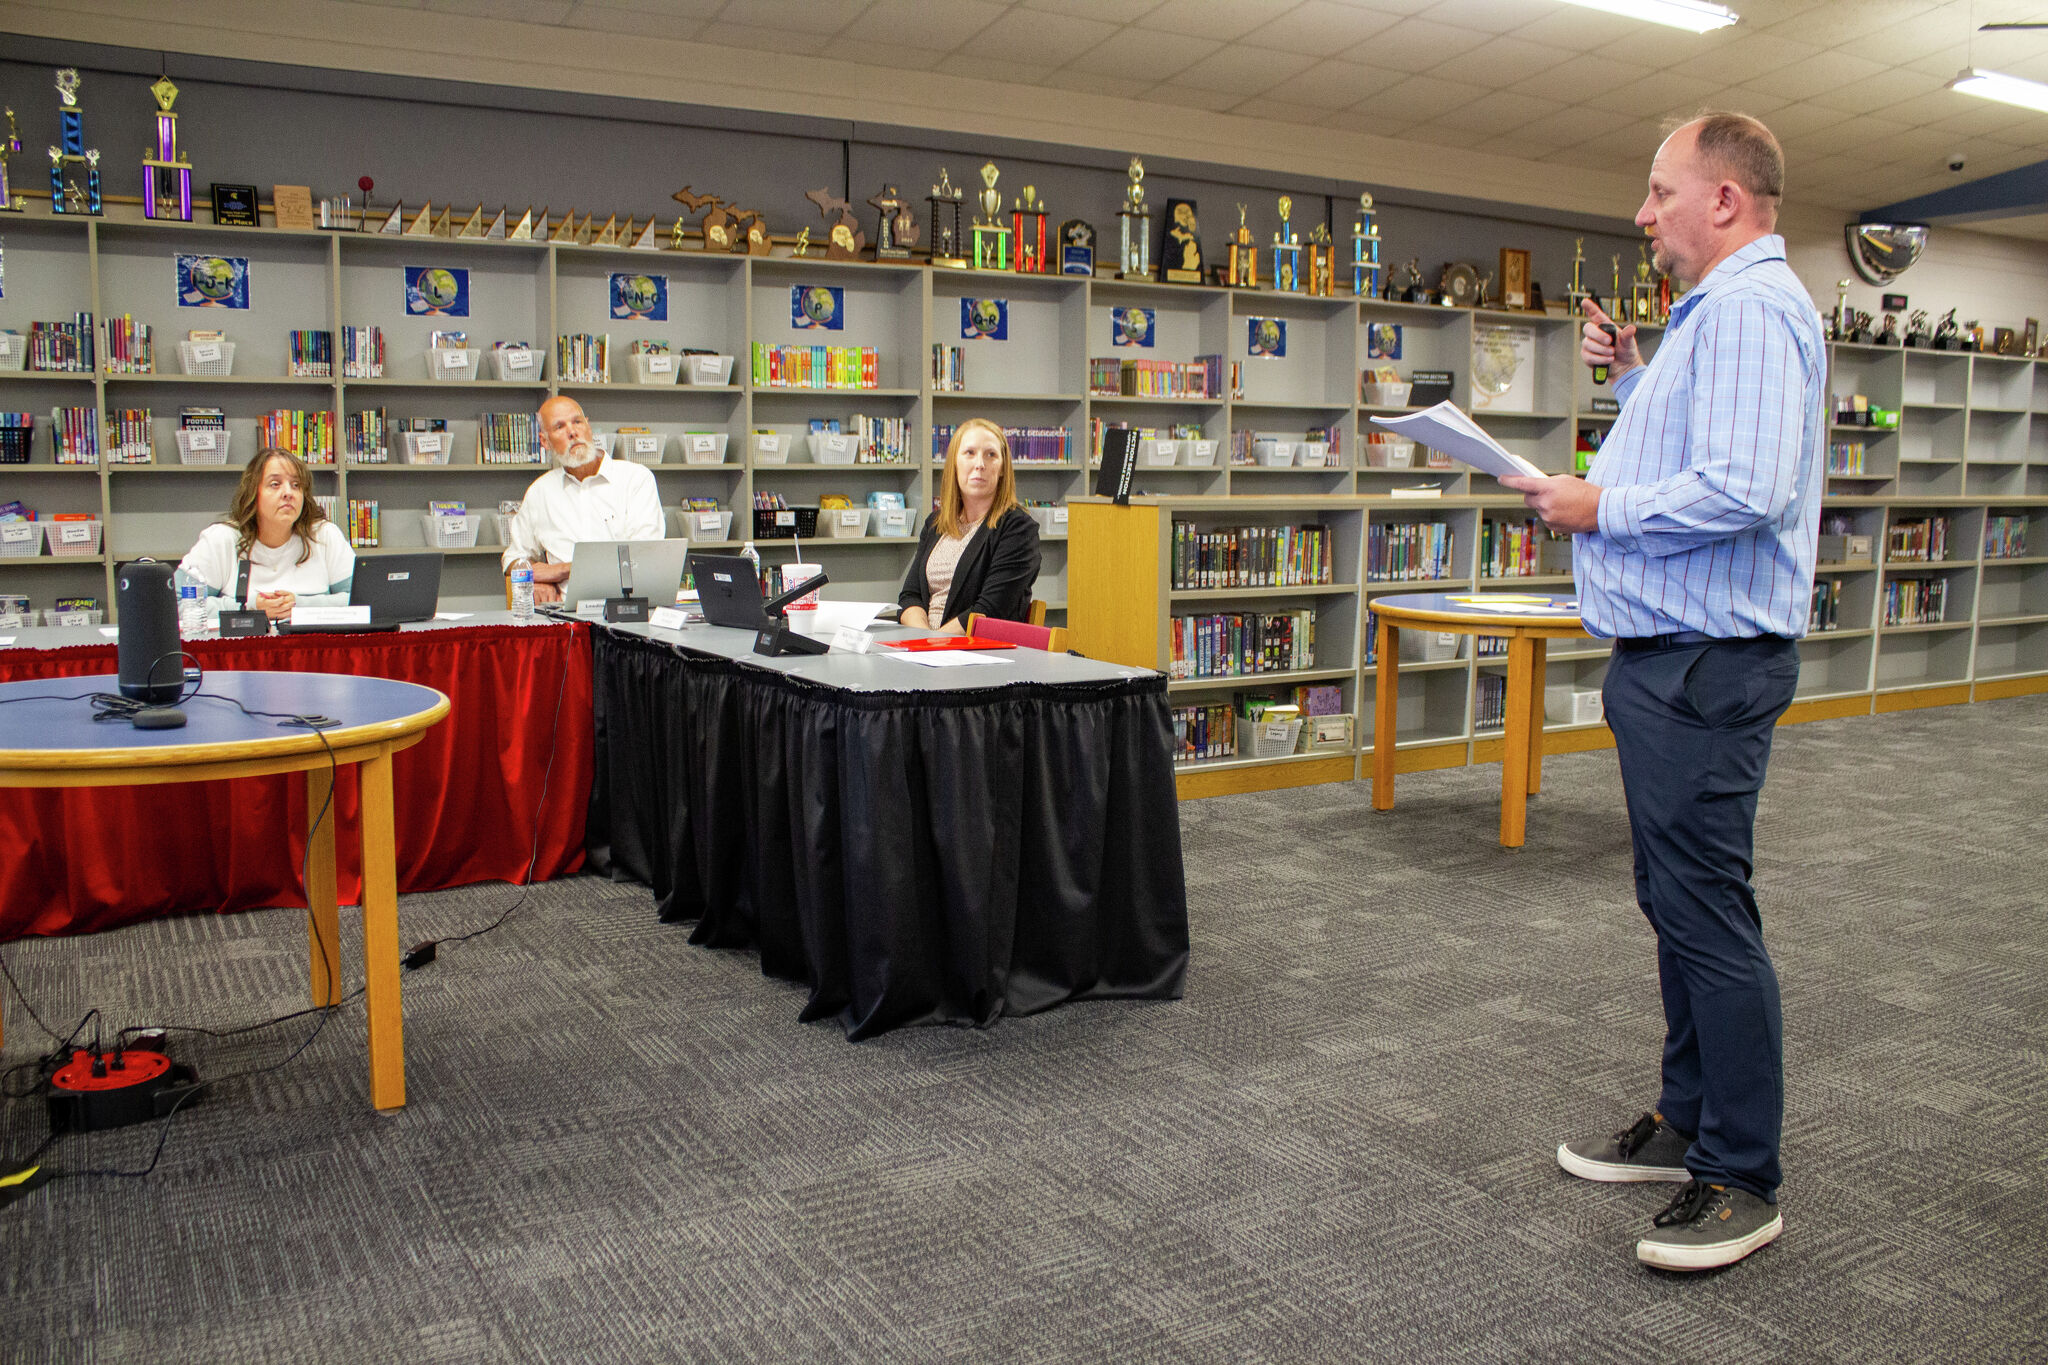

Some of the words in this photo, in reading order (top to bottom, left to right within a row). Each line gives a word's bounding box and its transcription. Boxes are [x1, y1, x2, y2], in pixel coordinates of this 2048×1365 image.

[434, 286, 442, 299] L
[814, 302, 823, 316] P
[974, 313, 996, 326] Q-R
[1128, 431, 1138, 461] FICTION
[1122, 462, 1133, 495] SECTION
